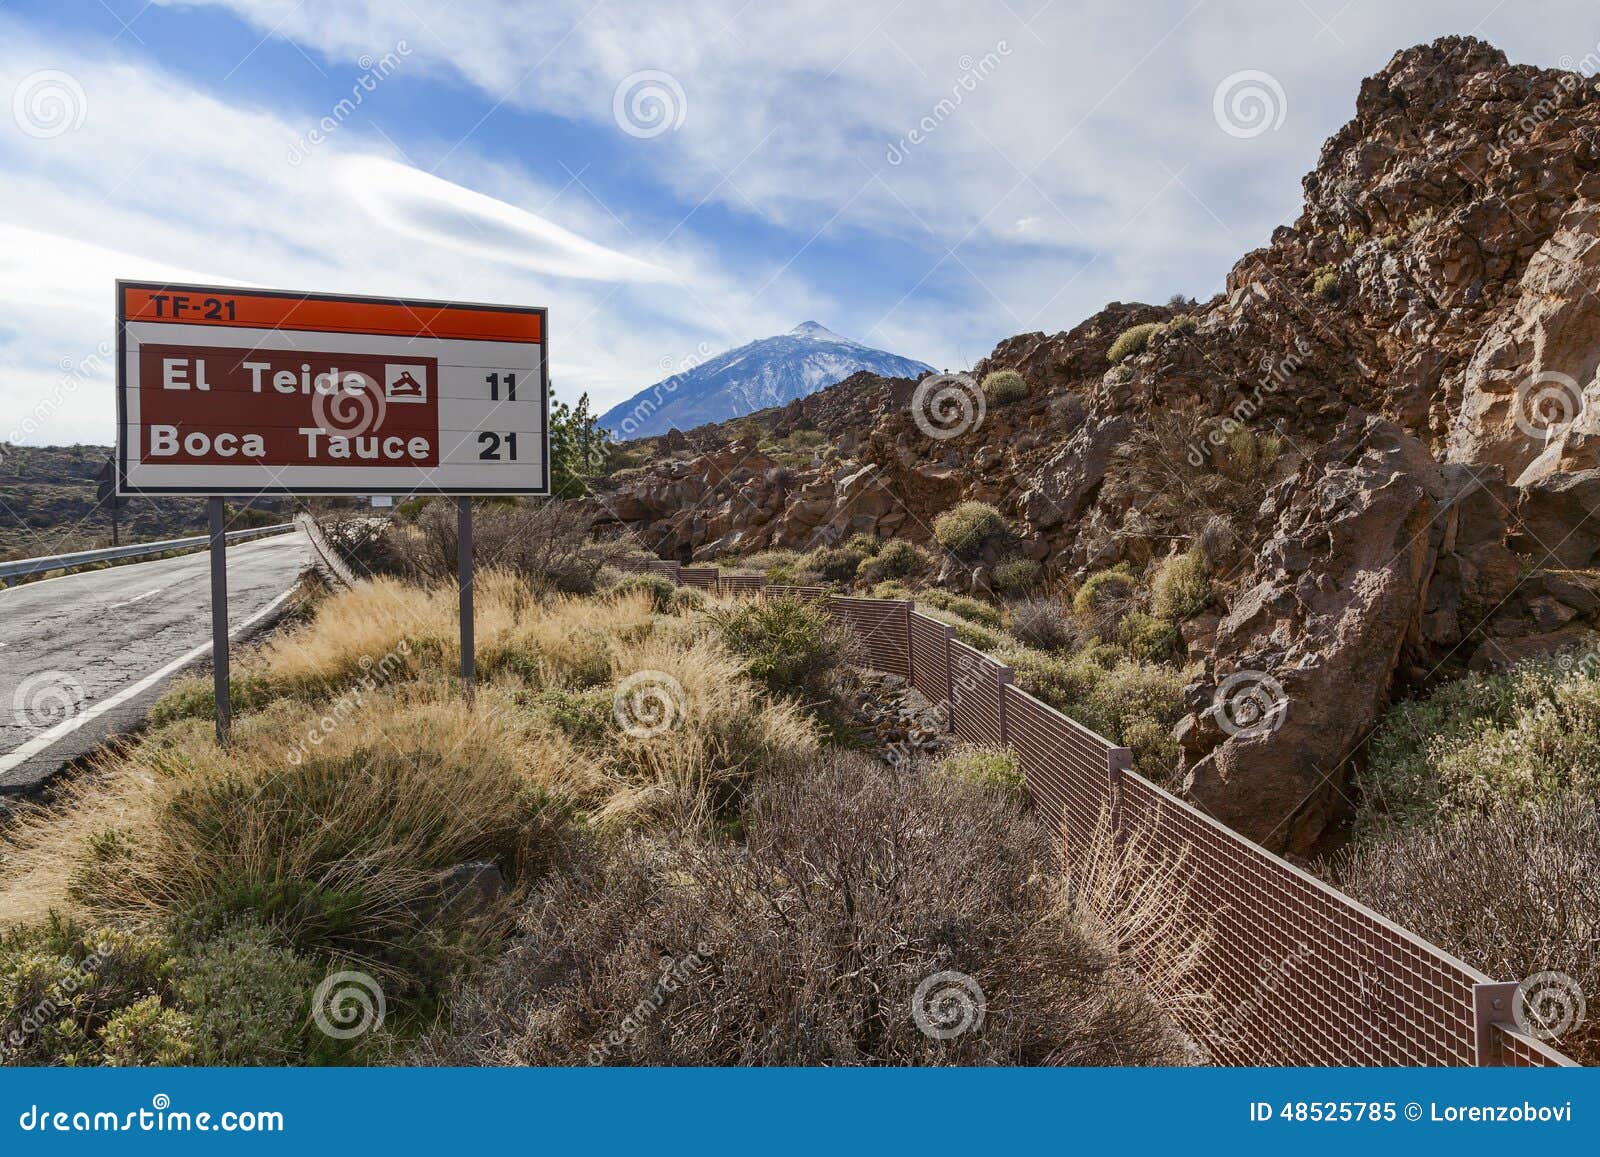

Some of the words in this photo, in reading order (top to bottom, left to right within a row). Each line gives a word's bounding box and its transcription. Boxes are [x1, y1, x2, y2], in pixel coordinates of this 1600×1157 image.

[149, 295, 236, 320] TF-21
[163, 358, 210, 391] El
[243, 362, 366, 395] Teide
[485, 373, 517, 401] 11
[150, 424, 266, 457] Boca
[299, 428, 430, 459] Tauce
[478, 432, 518, 461] 21
